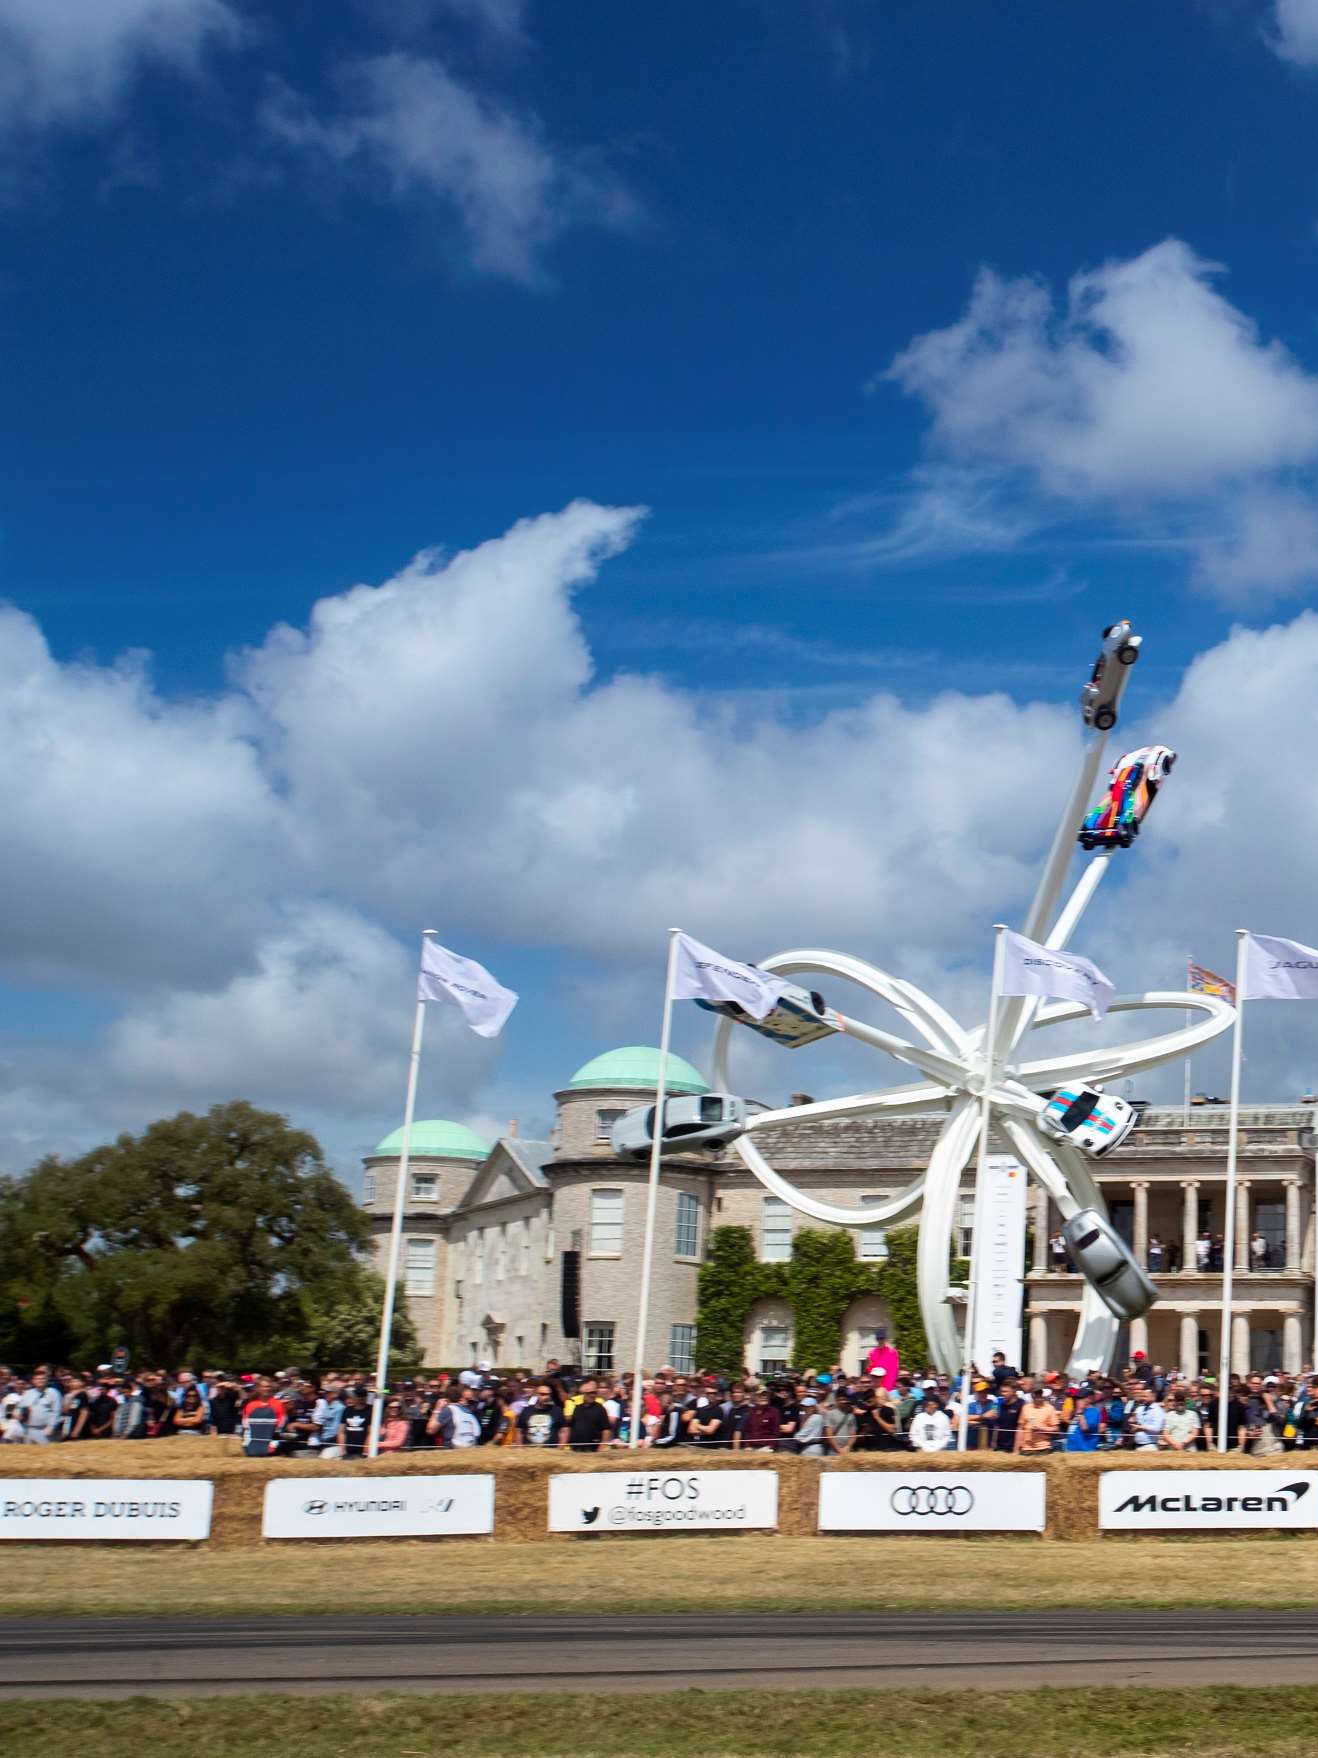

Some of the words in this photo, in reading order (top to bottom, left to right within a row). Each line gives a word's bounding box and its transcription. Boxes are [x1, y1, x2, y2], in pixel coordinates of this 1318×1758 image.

[625, 1477, 700, 1501] #FOS
[3, 1501, 86, 1518] ROGER
[92, 1501, 182, 1518] DUBUIS
[334, 1500, 408, 1513] HYUNDAI
[1113, 1493, 1288, 1513] McLaren
[607, 1504, 746, 1526] @fosgoodwood
